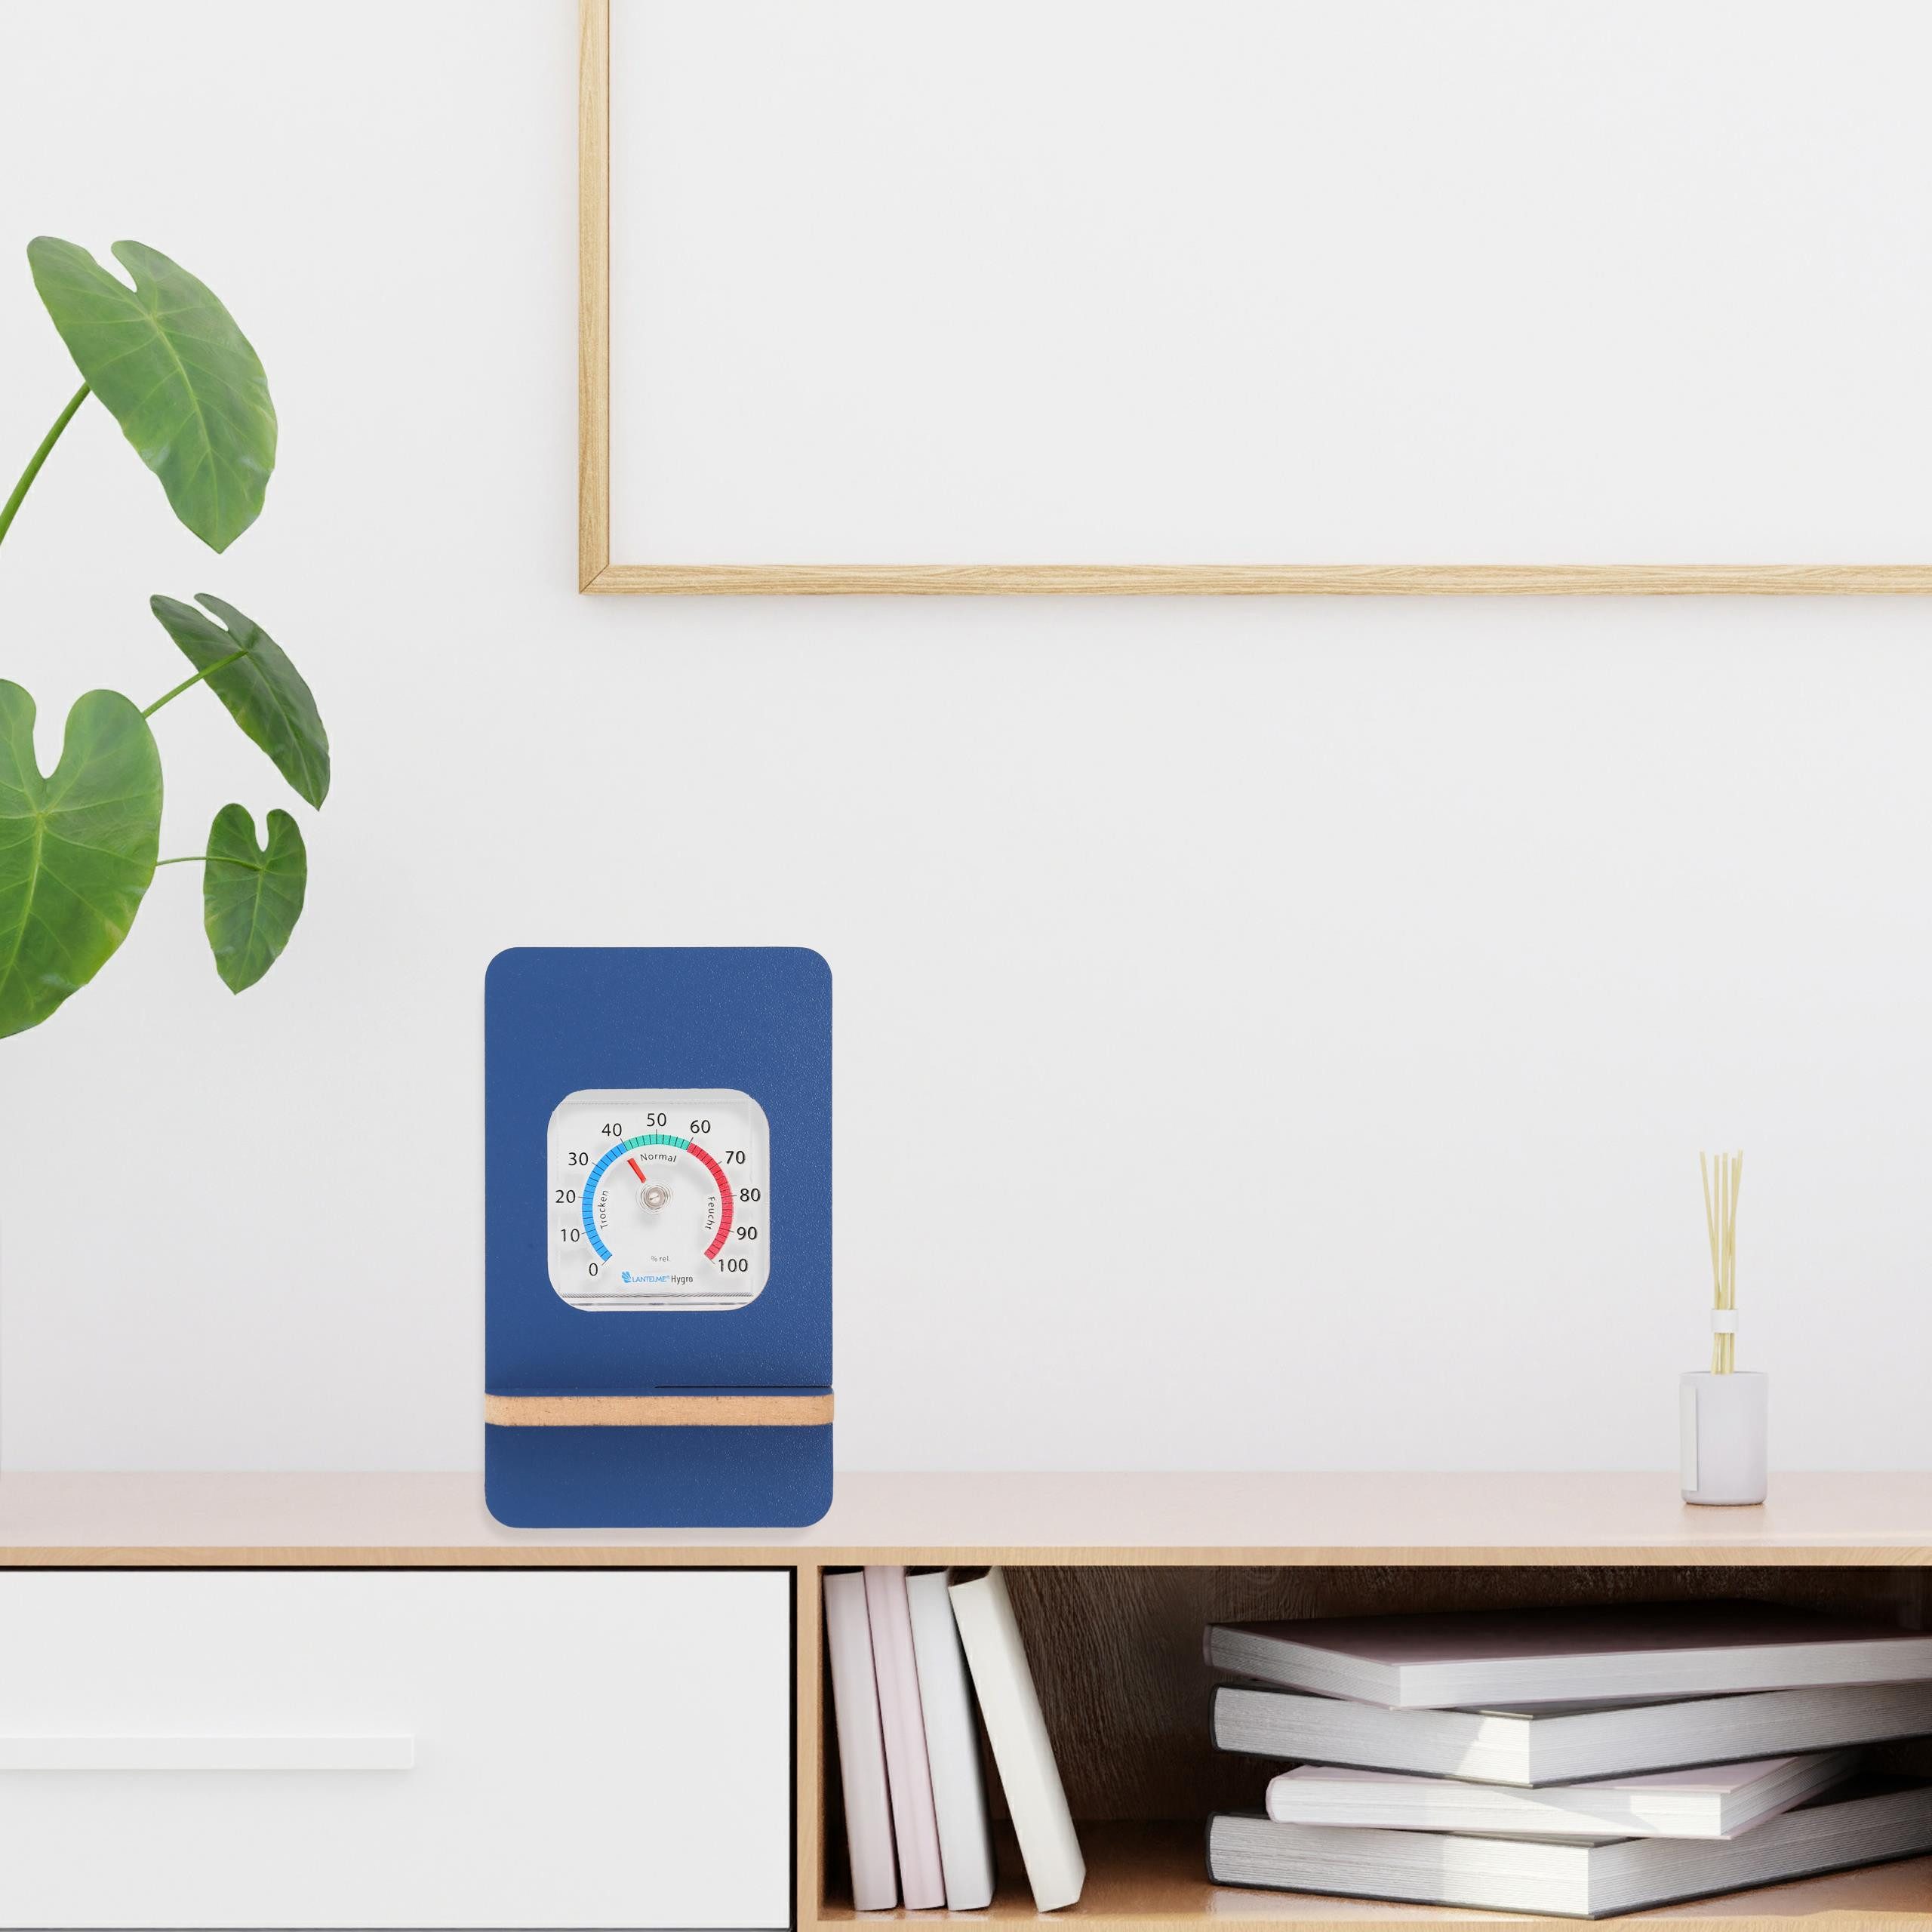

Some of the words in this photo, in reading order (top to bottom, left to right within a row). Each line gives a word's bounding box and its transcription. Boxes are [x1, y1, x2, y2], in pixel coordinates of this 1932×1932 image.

[647, 1113, 666, 1127] 50
[601, 1123, 622, 1137] 40
[691, 1120, 711, 1134] 60
[568, 1152, 588, 1165] 30
[640, 1153, 677, 1163] Normal
[725, 1151, 746, 1164] 70
[555, 1190, 575, 1203] 20
[740, 1188, 761, 1201] 80
[598, 1190, 609, 1229] Trocken
[705, 1196, 715, 1229] Feucht
[561, 1229, 580, 1242] 10
[737, 1226, 758, 1240] 90
[589, 1263, 598, 1276] 0
[718, 1258, 748, 1272] 100
[672, 1275, 694, 1284] Hygro
